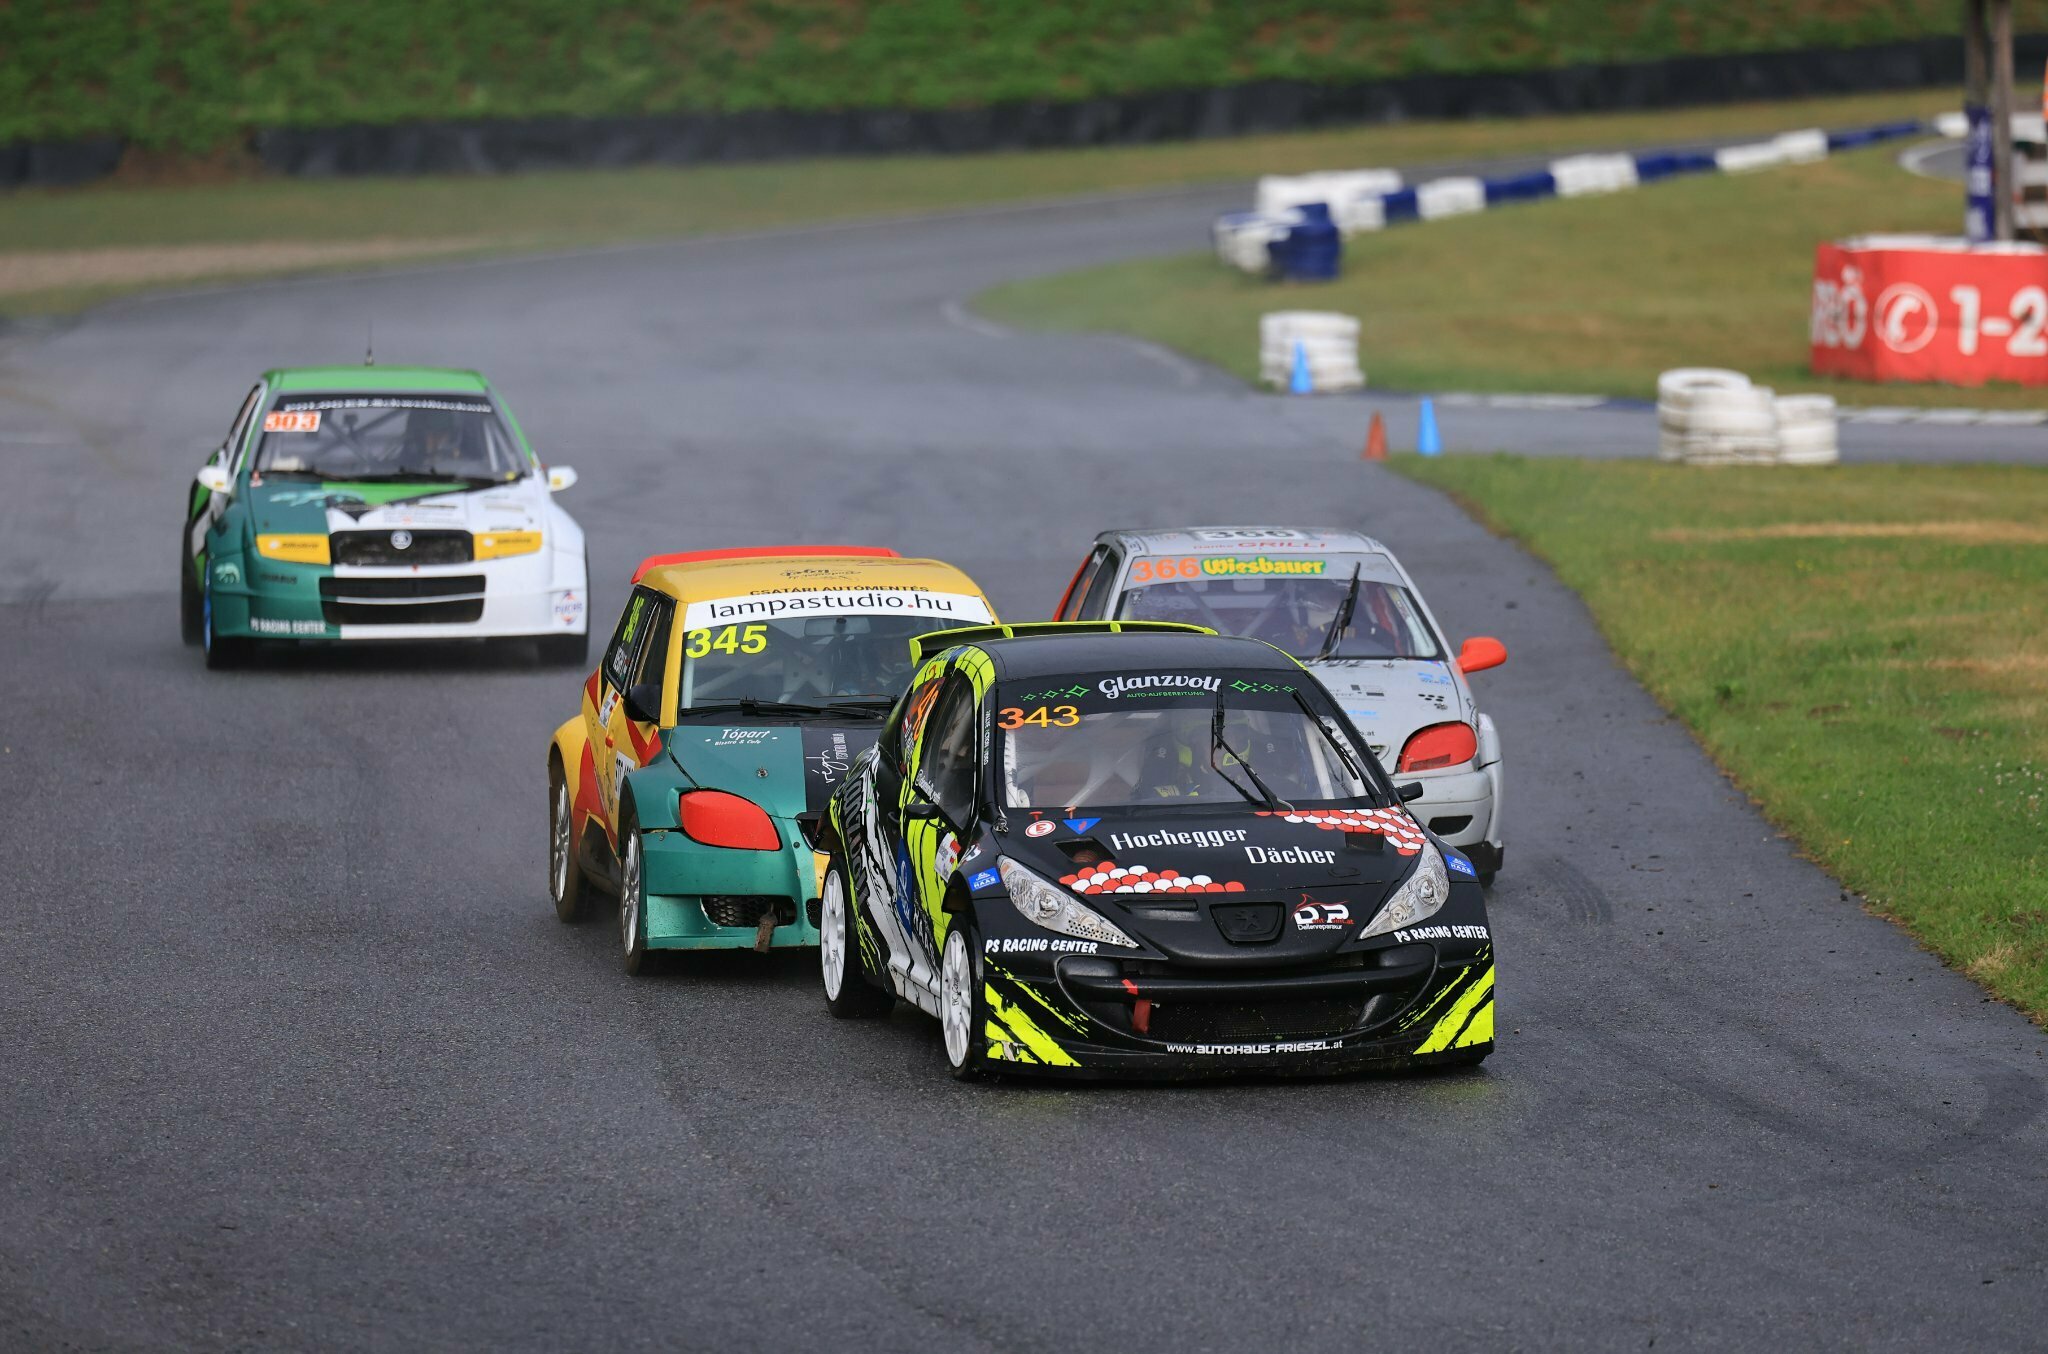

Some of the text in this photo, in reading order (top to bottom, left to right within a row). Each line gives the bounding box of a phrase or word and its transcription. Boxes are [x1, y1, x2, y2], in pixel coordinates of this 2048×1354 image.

[264, 412, 316, 430] 303
[1132, 556, 1327, 583] 366 Wiesbauer
[750, 586, 818, 596] CSATÁRI
[710, 592, 953, 619] lampastudio.hu
[685, 625, 768, 658] 345
[1098, 675, 1222, 699] Glanzvoll
[997, 705, 1080, 730] 343
[722, 729, 771, 741] Tópart
[1110, 829, 1247, 851] Hochegger
[1244, 846, 1336, 865] Dächer
[974, 877, 996, 889] HAAS
[1393, 925, 1490, 943] PS RACING CENTER
[985, 939, 1099, 954] PS RACING CENTER
